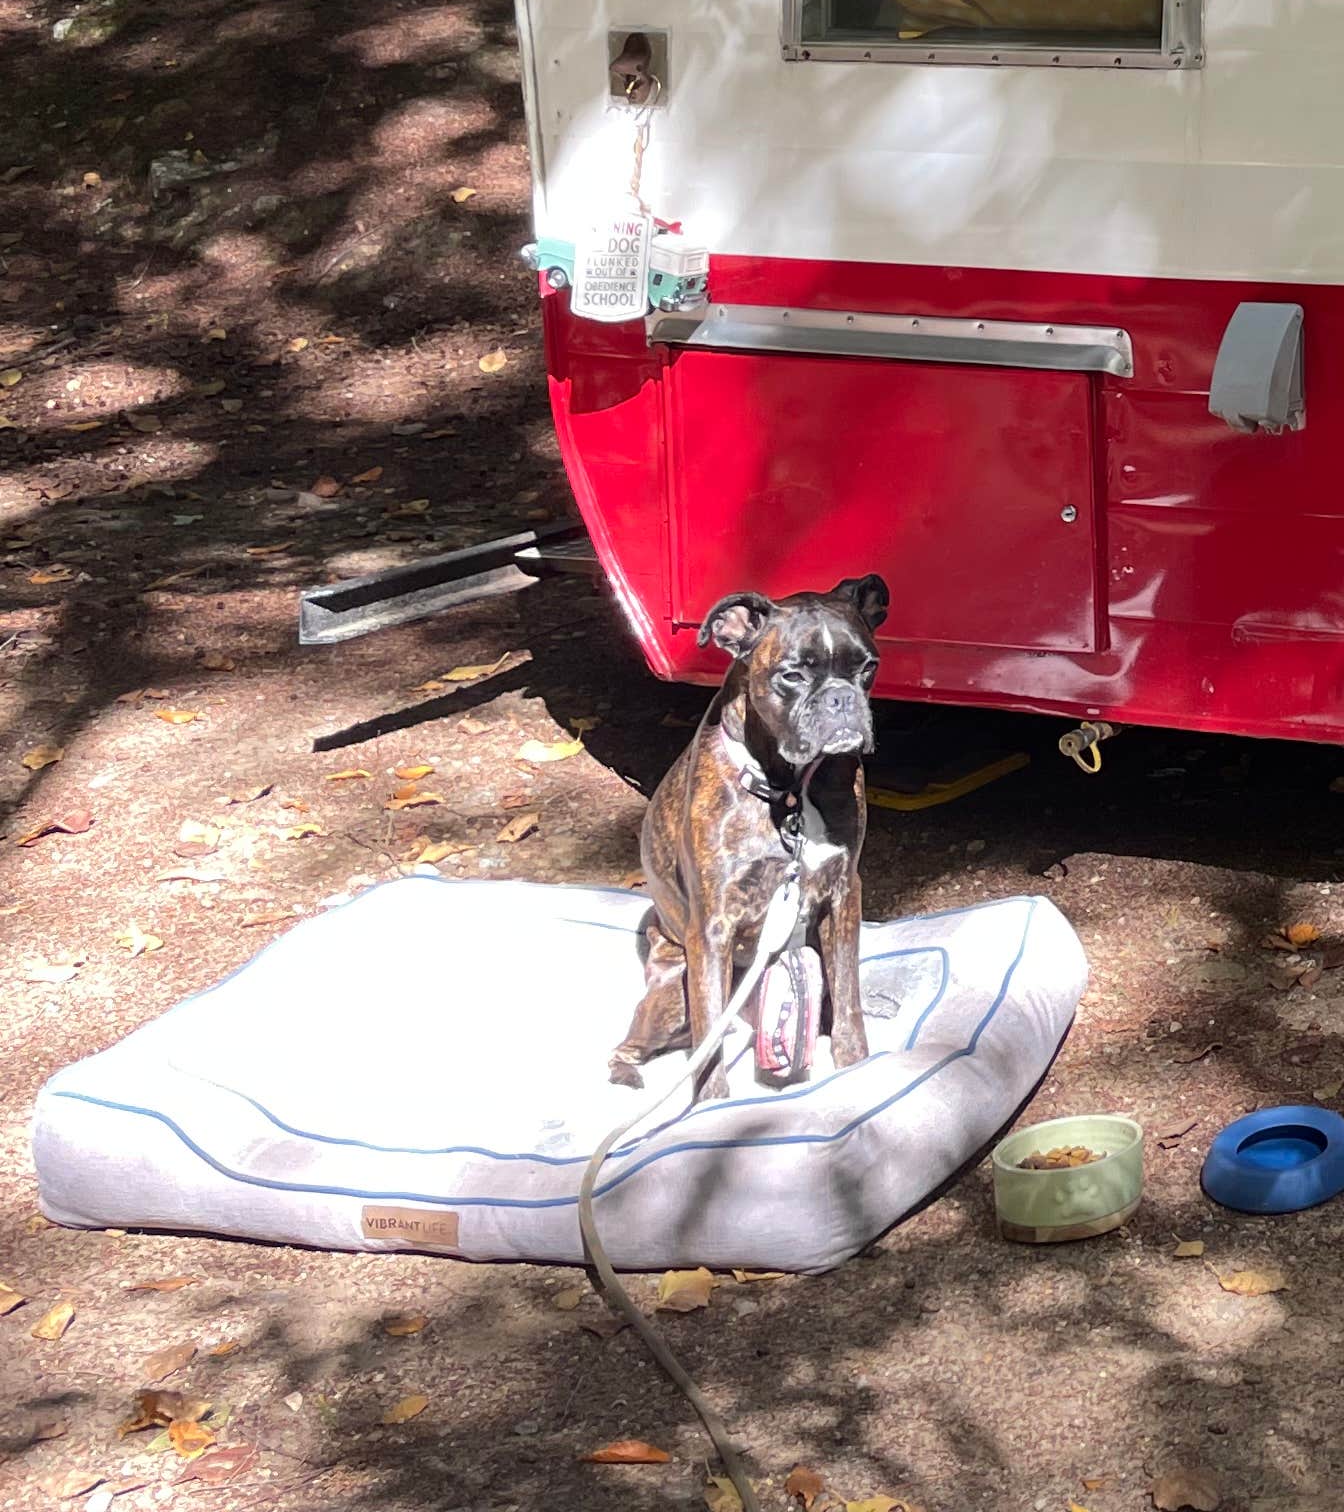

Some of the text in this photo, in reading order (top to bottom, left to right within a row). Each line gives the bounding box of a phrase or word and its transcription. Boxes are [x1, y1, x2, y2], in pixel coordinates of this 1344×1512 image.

[607, 237, 641, 254] DOG
[584, 281, 637, 293] OBEDIENCE
[583, 292, 636, 307] SCHOOL
[366, 1216, 422, 1232] VIBRANT
